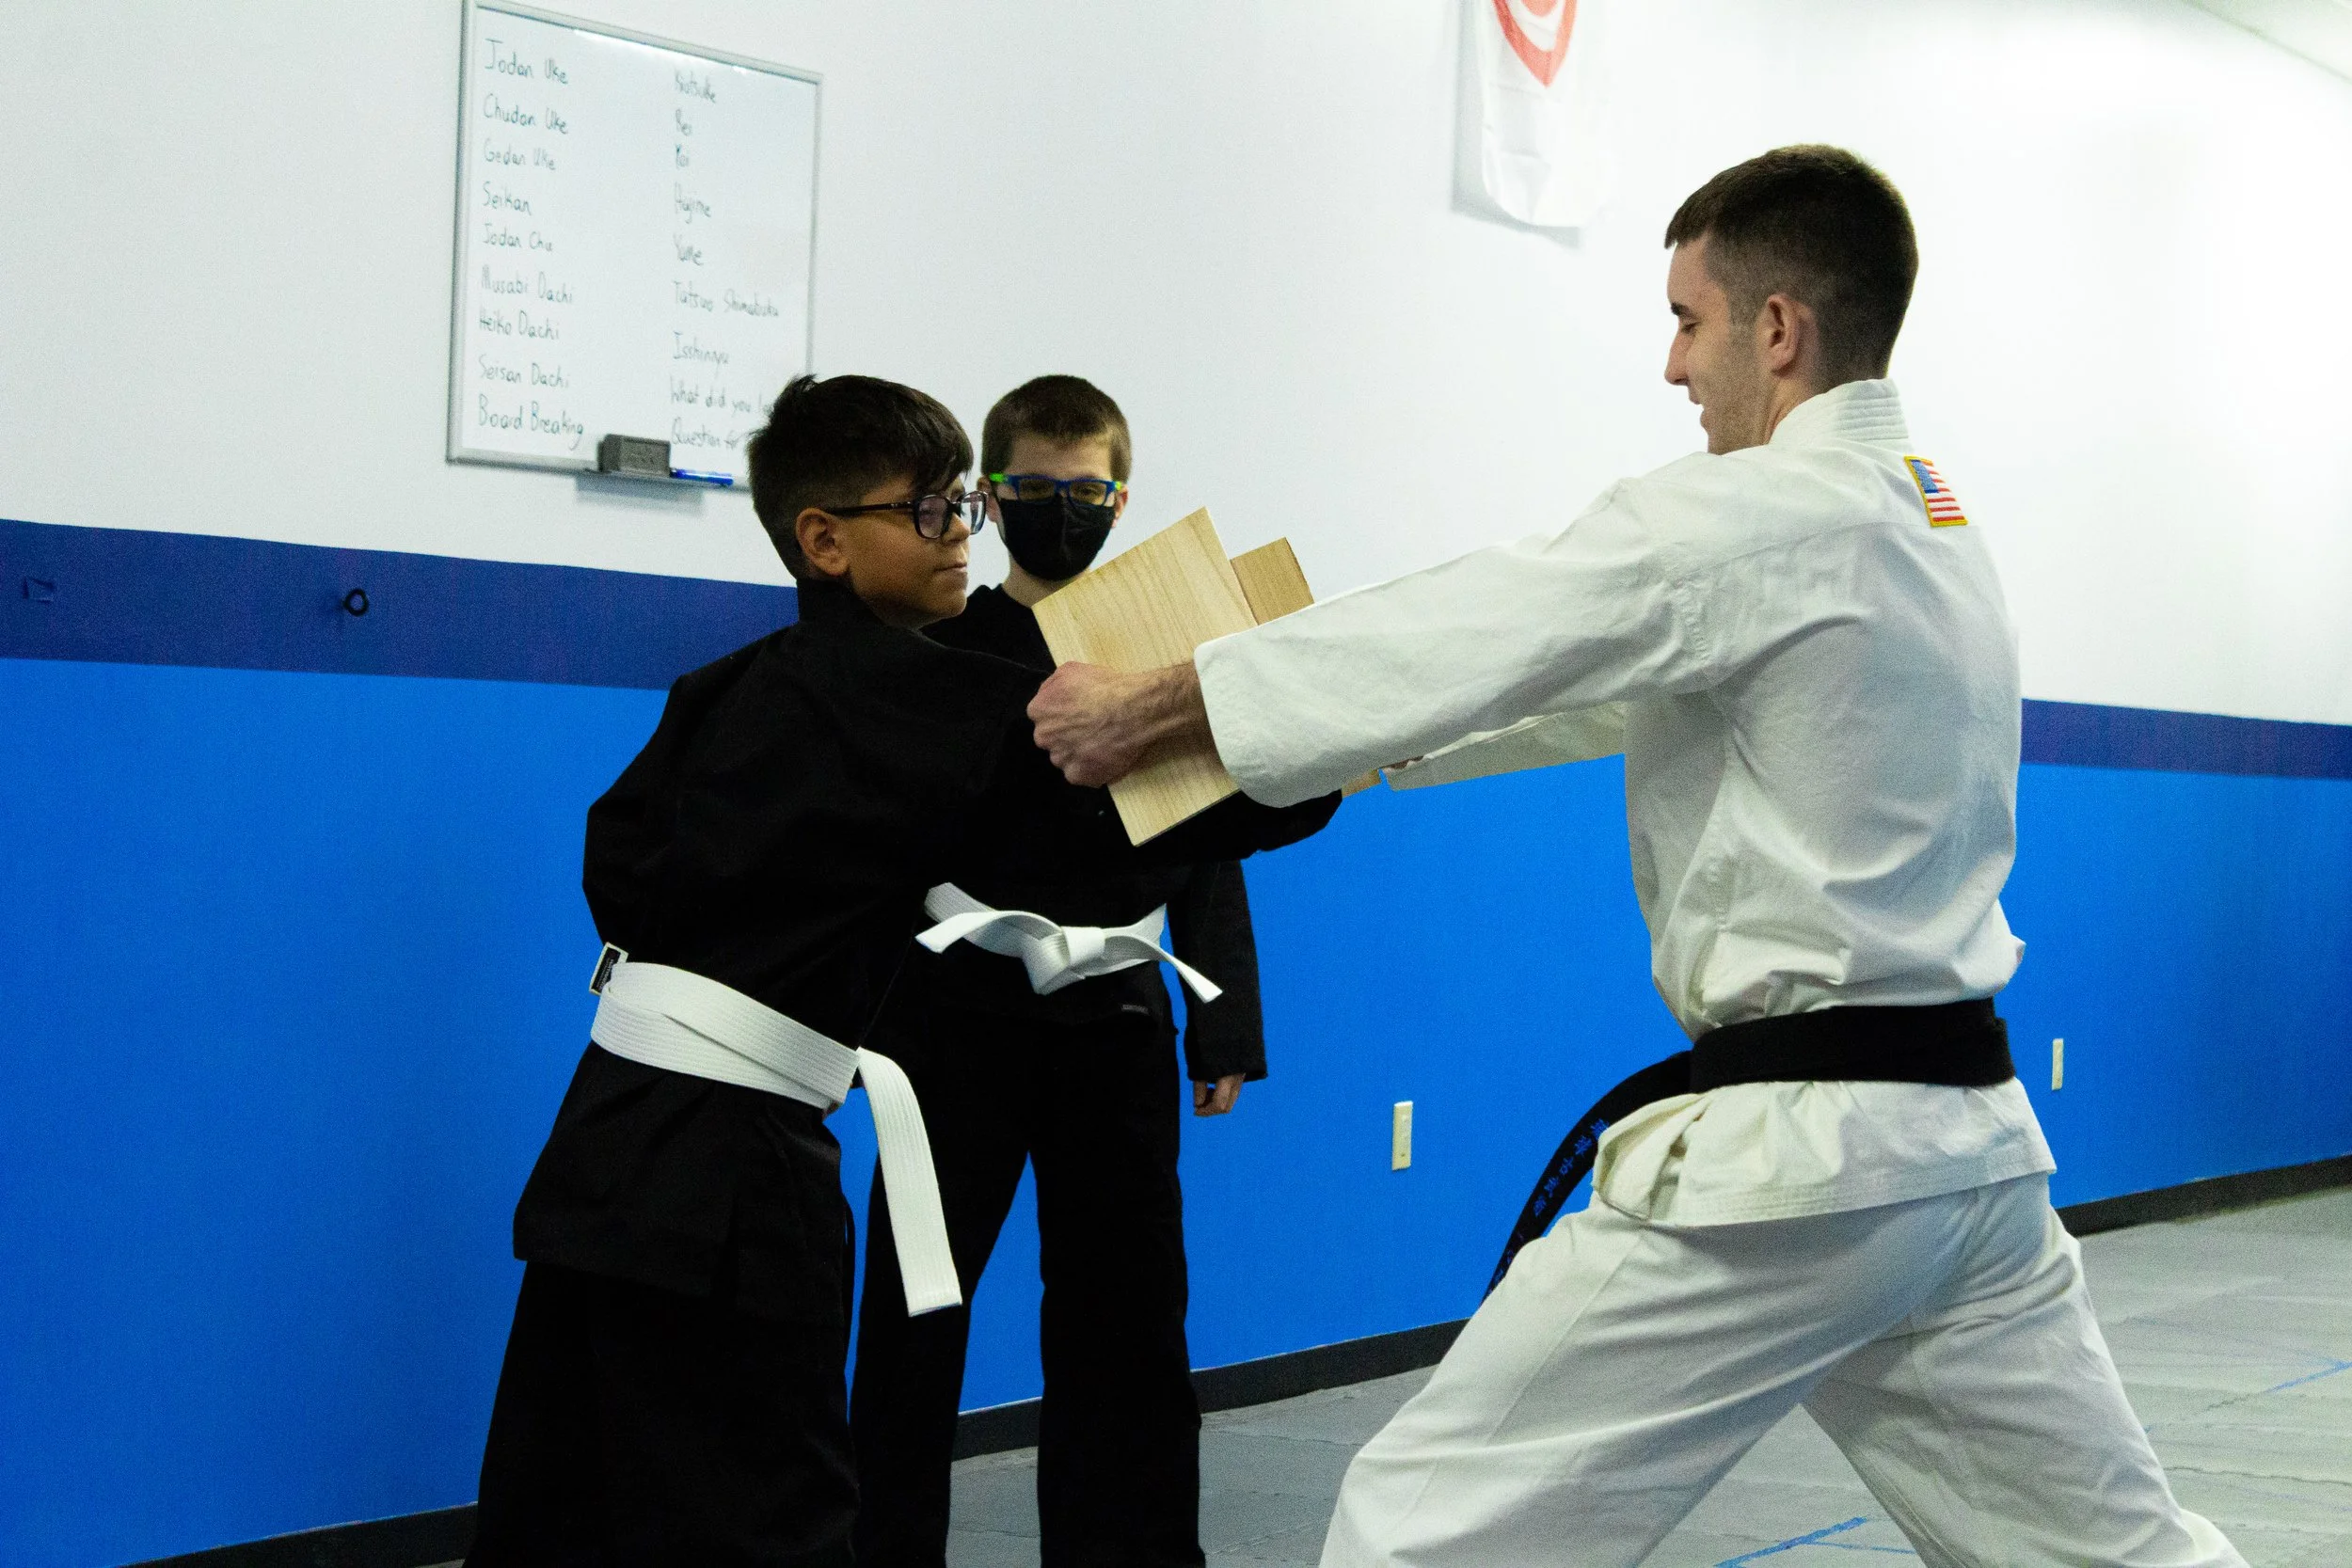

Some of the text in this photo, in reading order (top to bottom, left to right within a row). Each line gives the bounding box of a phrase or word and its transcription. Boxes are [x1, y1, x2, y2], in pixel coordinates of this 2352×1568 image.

[484, 37, 569, 85] Jodan Uke
[483, 92, 569, 135] Chudan Uke
[484, 137, 556, 171] Gedan Uke
[483, 222, 523, 248] Jodan
[537, 271, 573, 305] Dachi
[479, 306, 560, 341] Heiko Dachi
[478, 352, 570, 388] Seisan Dachi
[706, 385, 725, 408] did
[478, 392, 584, 451] Board Breaking
